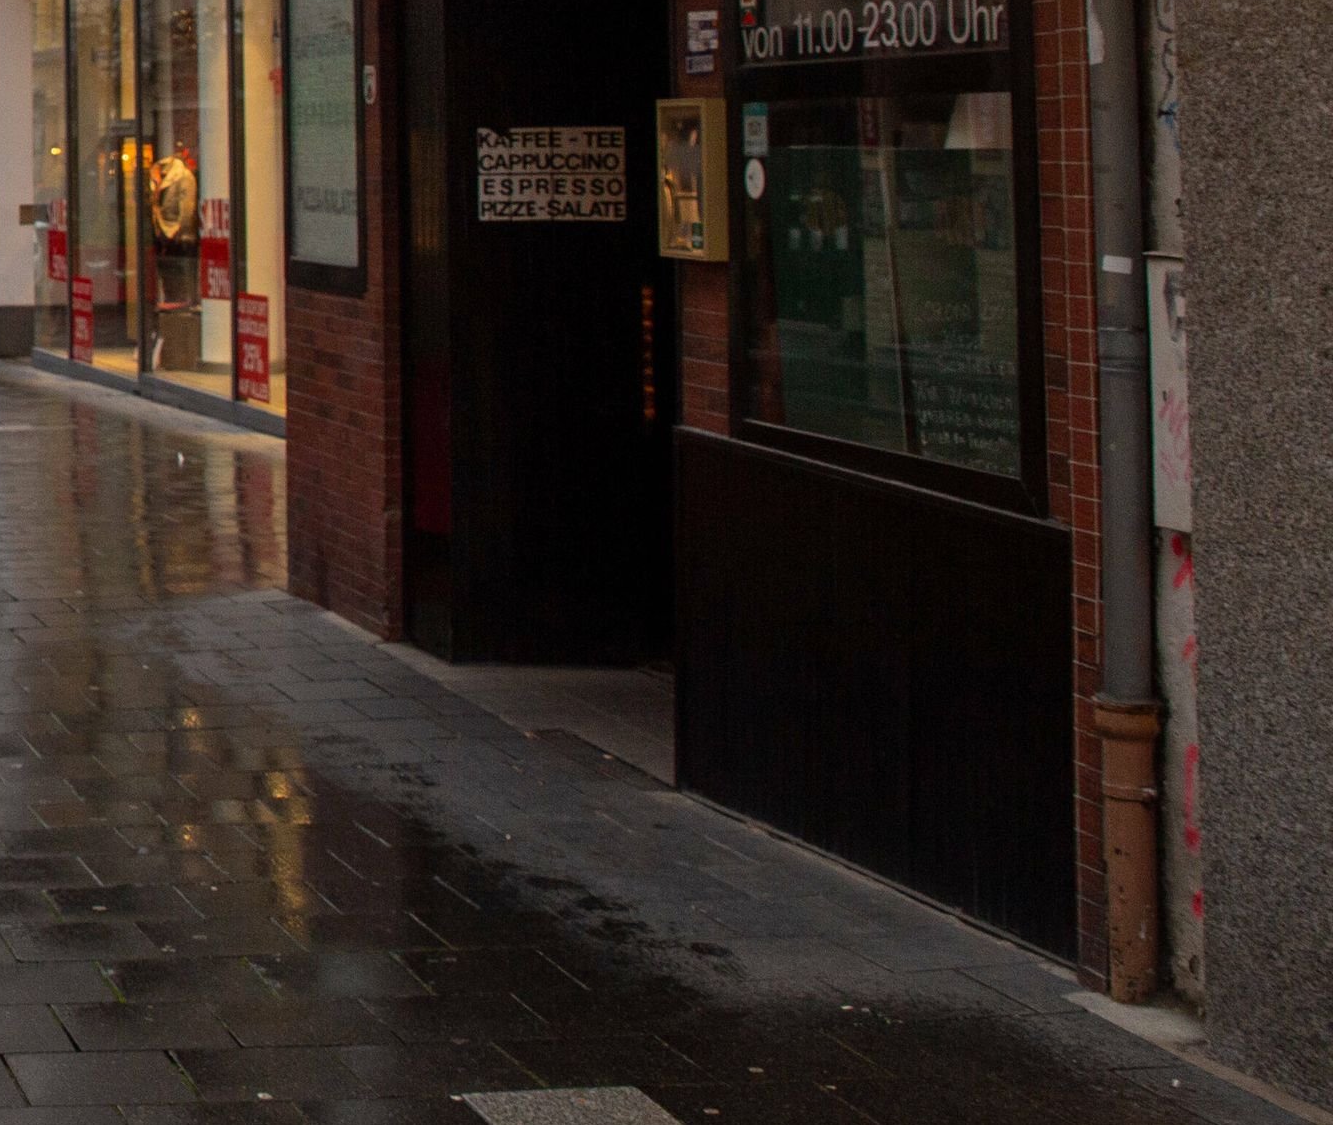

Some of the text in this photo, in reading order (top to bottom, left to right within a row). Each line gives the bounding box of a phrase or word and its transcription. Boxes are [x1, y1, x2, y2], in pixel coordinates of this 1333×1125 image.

[742, 25, 782, 60] von
[478, 131, 562, 149] KAFFEE
[583, 131, 624, 148] TEE
[478, 153, 620, 171] CAPPUCCINO
[483, 178, 624, 196] ESPRESSO
